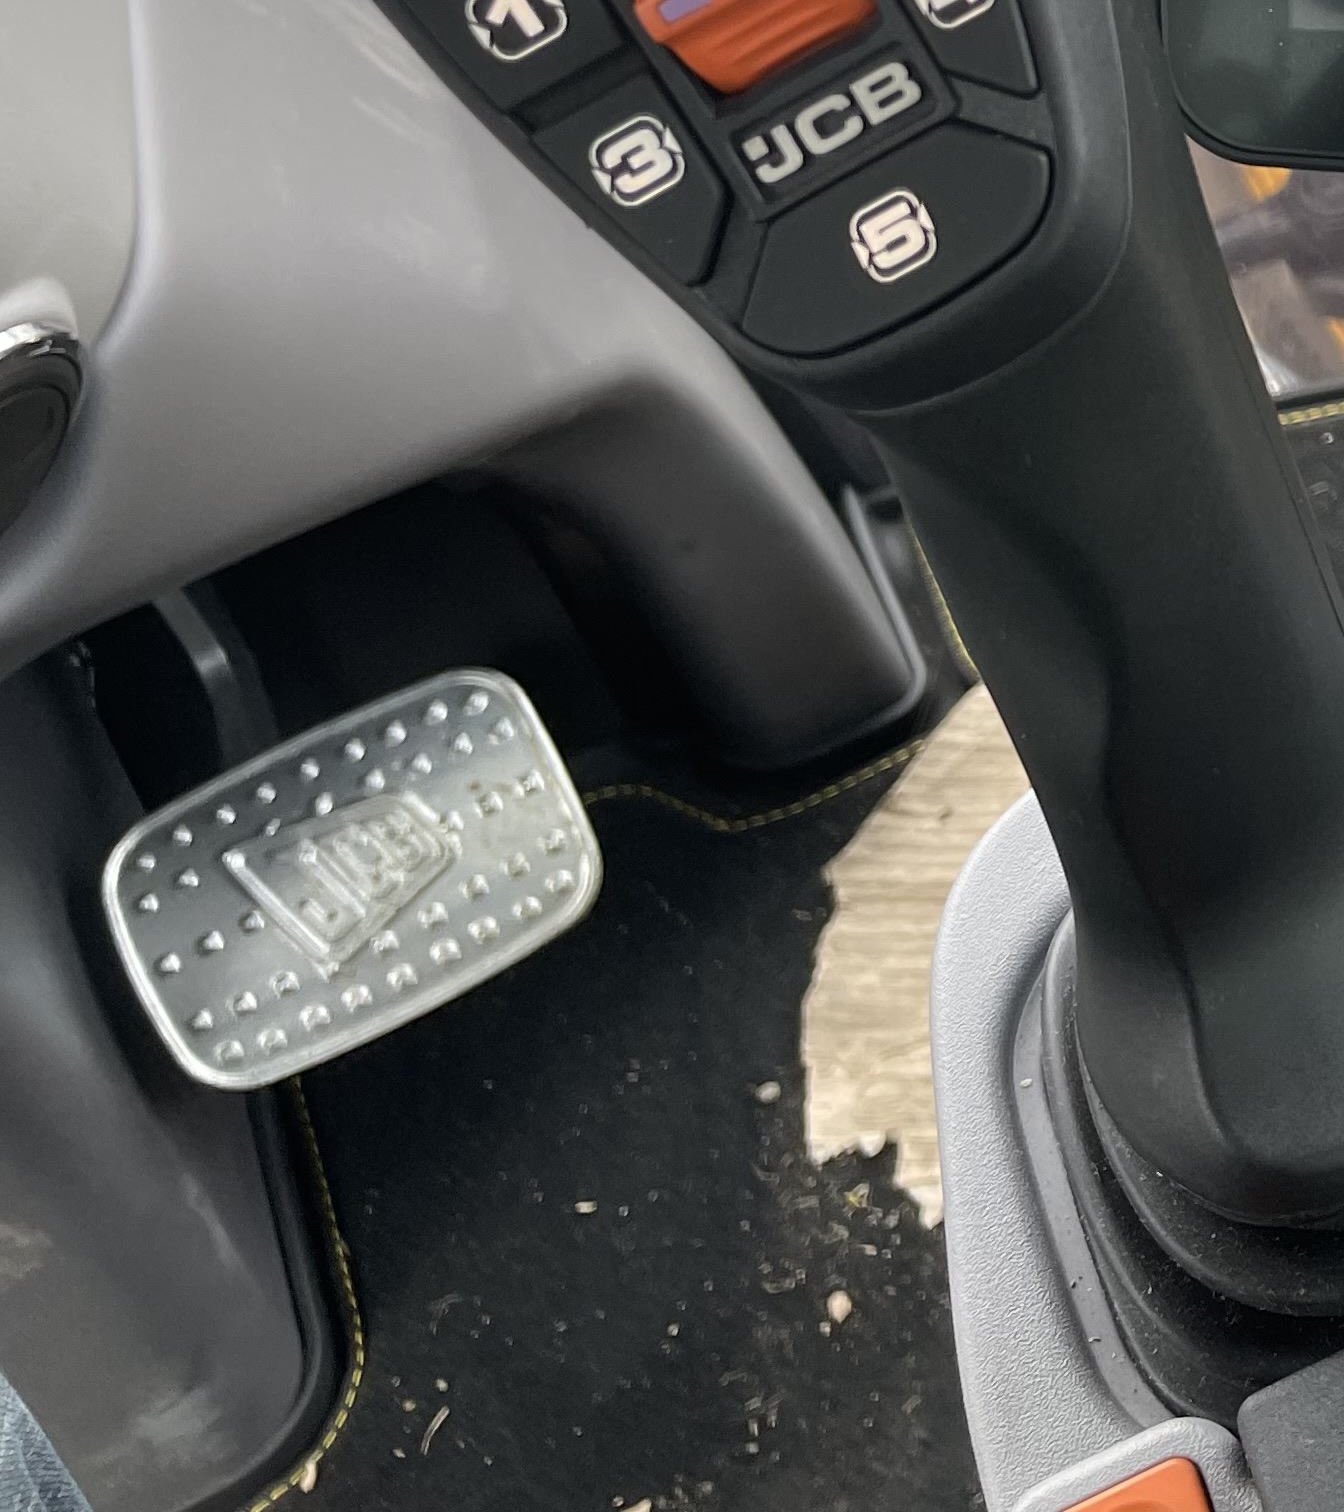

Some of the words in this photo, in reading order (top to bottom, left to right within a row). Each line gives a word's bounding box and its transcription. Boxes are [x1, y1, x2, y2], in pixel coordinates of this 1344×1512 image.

[744, 61, 923, 184] JCB
[598, 133, 672, 195] 3
[858, 201, 925, 273] 5
